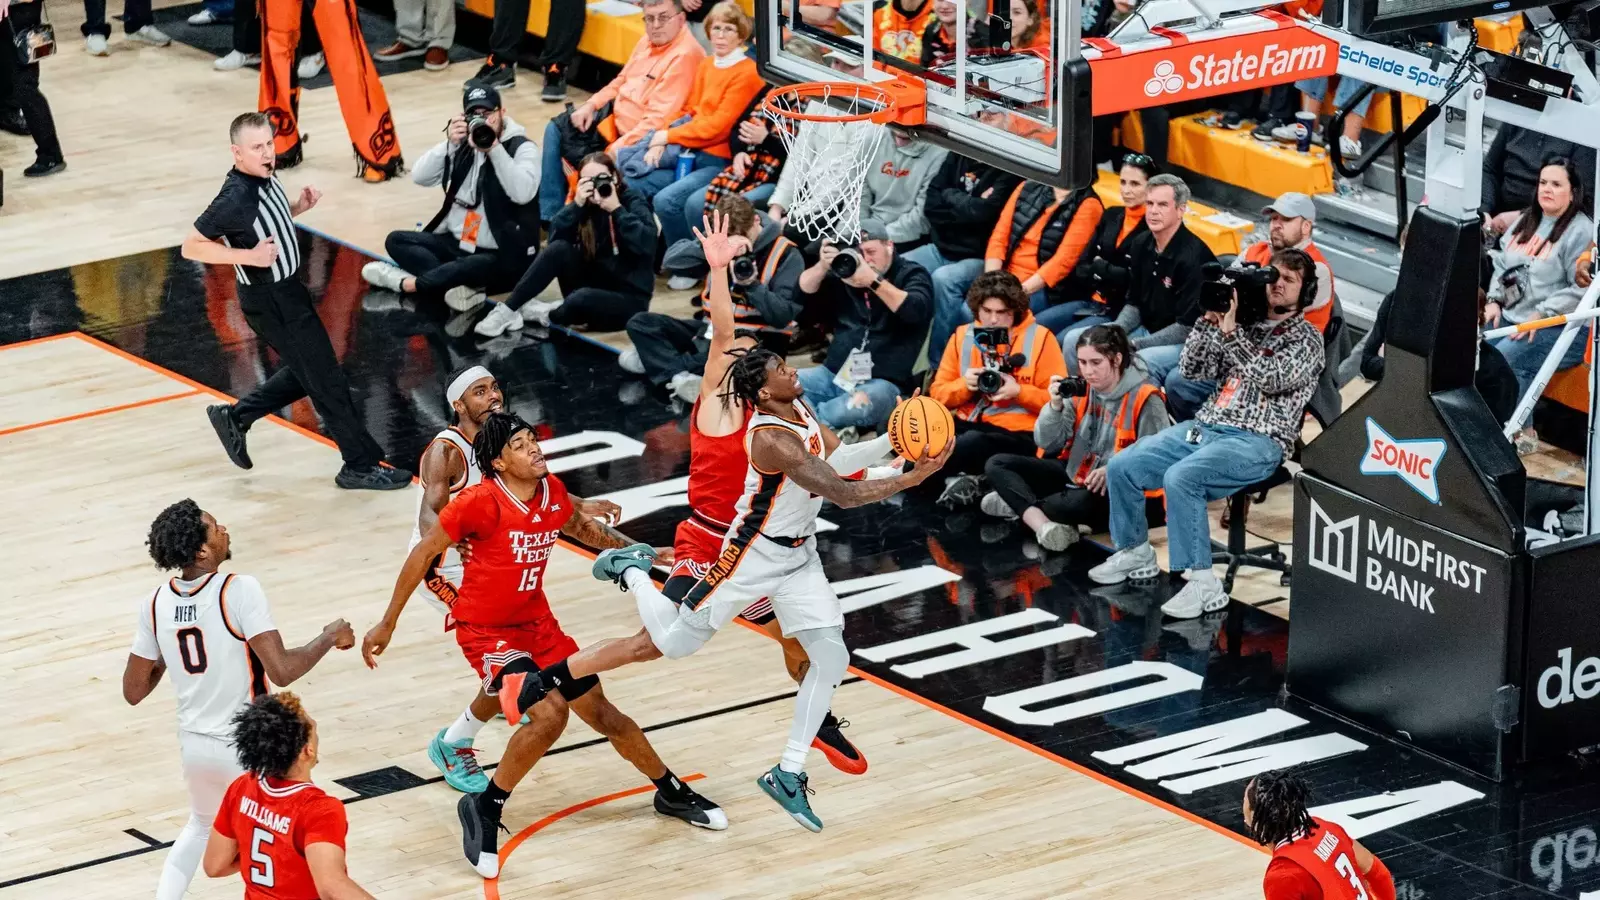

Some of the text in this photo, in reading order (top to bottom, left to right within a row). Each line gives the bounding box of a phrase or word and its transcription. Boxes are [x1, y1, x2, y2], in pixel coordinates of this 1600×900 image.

[1339, 45, 1460, 90] Schelde Spor
[1371, 439, 1432, 480] SONIC
[509, 529, 560, 549] TEXAS
[513, 546, 553, 563] TECH
[517, 566, 541, 592] 15
[1365, 556, 1435, 614] BANK
[174, 604, 197, 623] AVERY
[176, 626, 208, 675] 0
[239, 795, 292, 835] WILLIAMS
[249, 825, 276, 889] 5
[1334, 852, 1370, 900] 3
